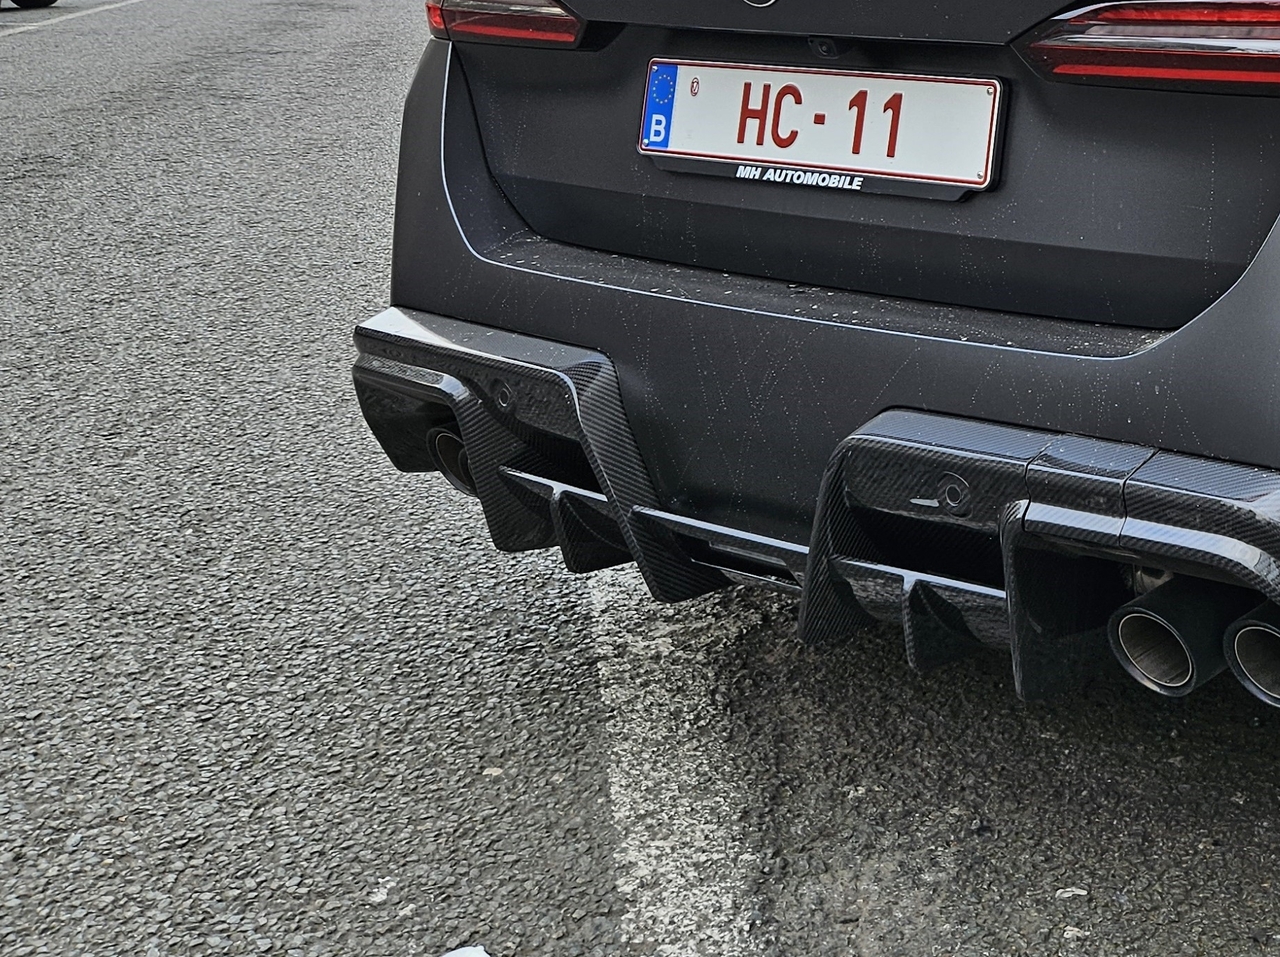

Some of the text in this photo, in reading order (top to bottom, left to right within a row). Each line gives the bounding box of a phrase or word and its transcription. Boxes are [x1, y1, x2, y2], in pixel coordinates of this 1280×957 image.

[649, 113, 667, 143] B
[736, 165, 864, 190] MH AUTOMOBILE
